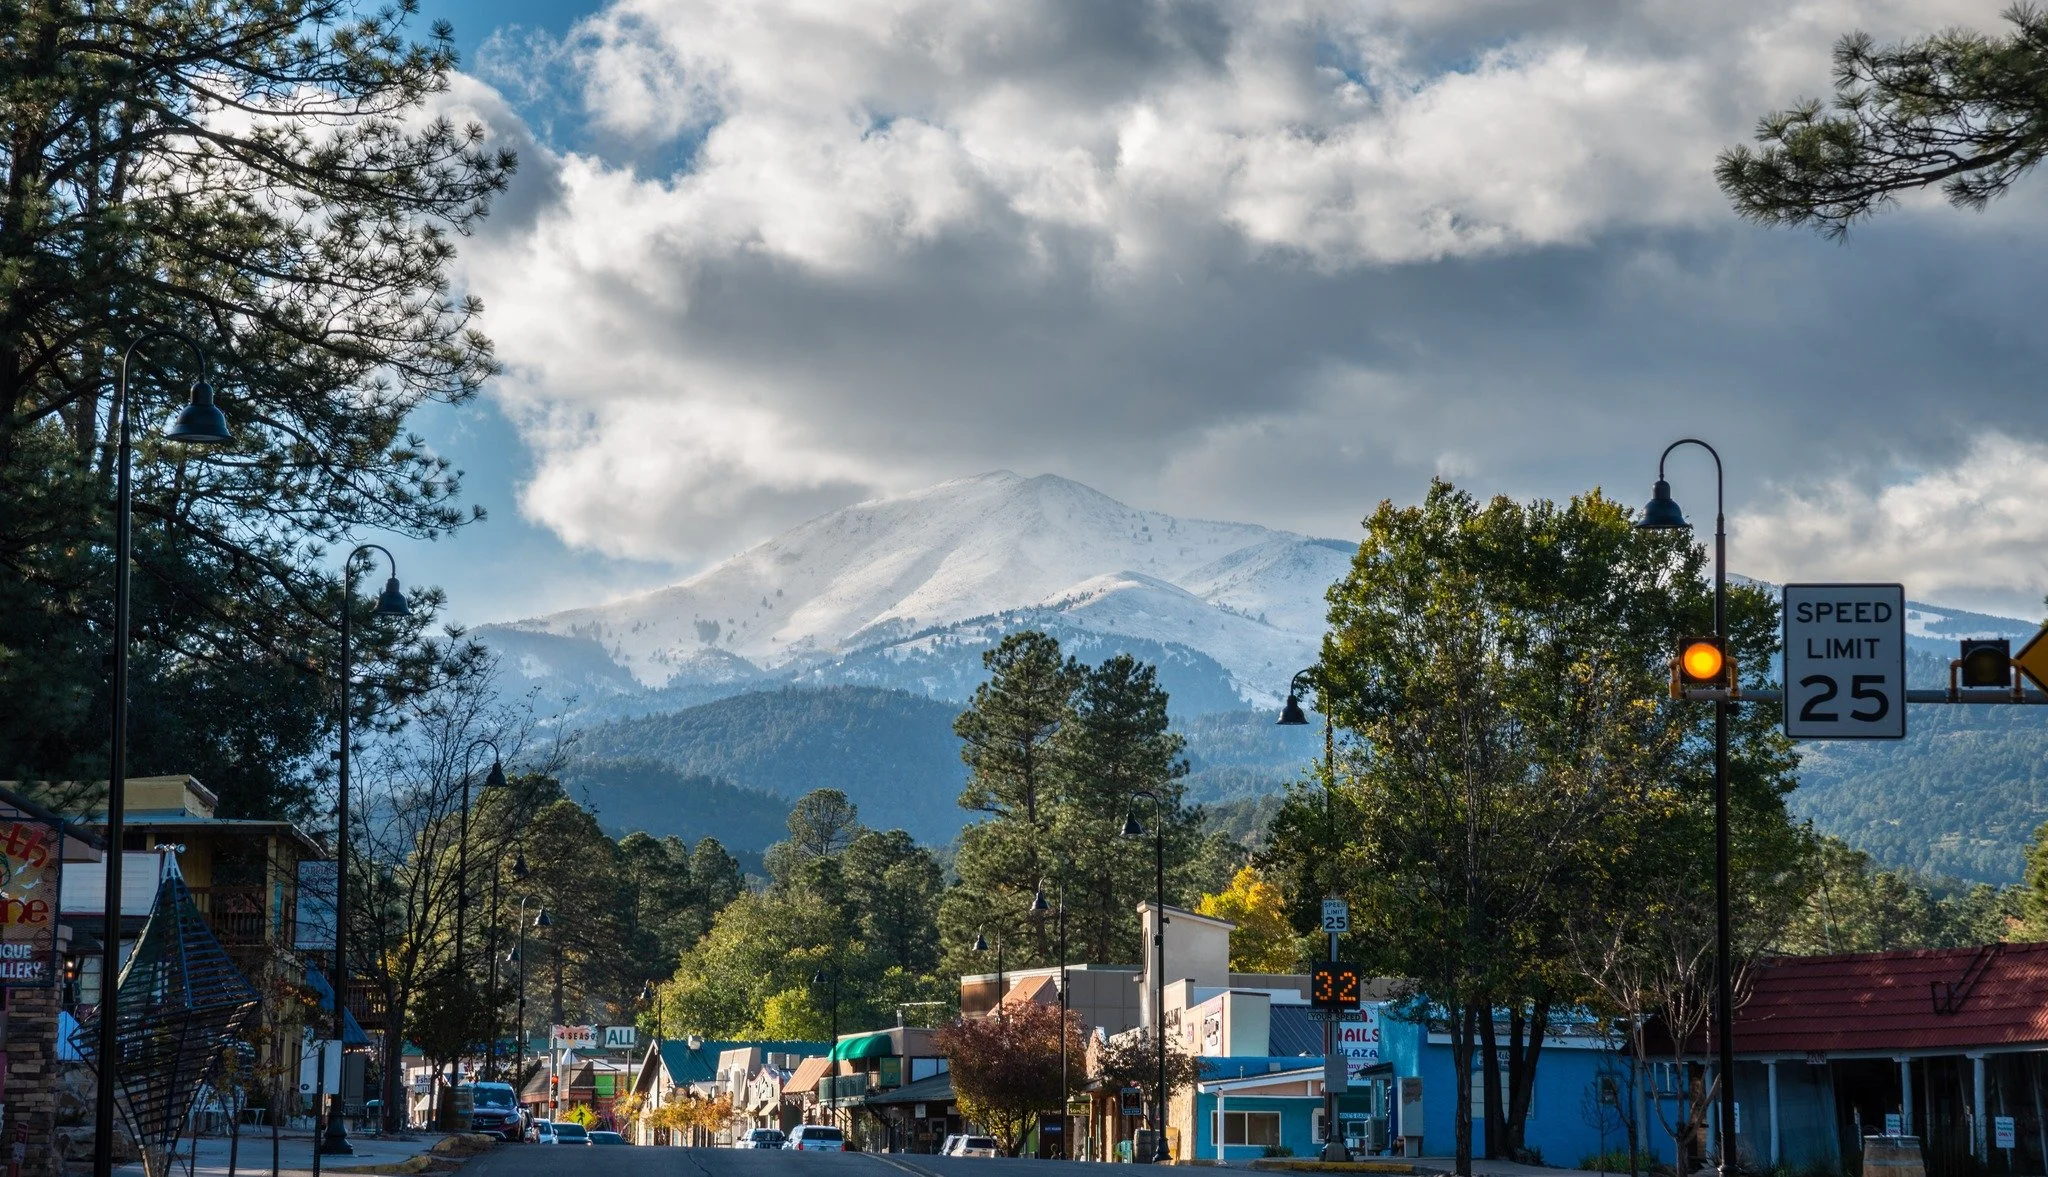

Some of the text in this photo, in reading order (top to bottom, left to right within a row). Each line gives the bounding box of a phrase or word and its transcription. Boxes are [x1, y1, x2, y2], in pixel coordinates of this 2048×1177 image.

[1796, 602, 1892, 623] SPEED
[1807, 638, 1880, 659] LIMIT
[1799, 675, 1889, 722] 25
[1325, 916, 1346, 929] 25
[0, 961, 42, 979] LLERY
[1315, 971, 1357, 1002] 32
[560, 1032, 565, 1040] 4
[604, 1030, 634, 1045] ALL
